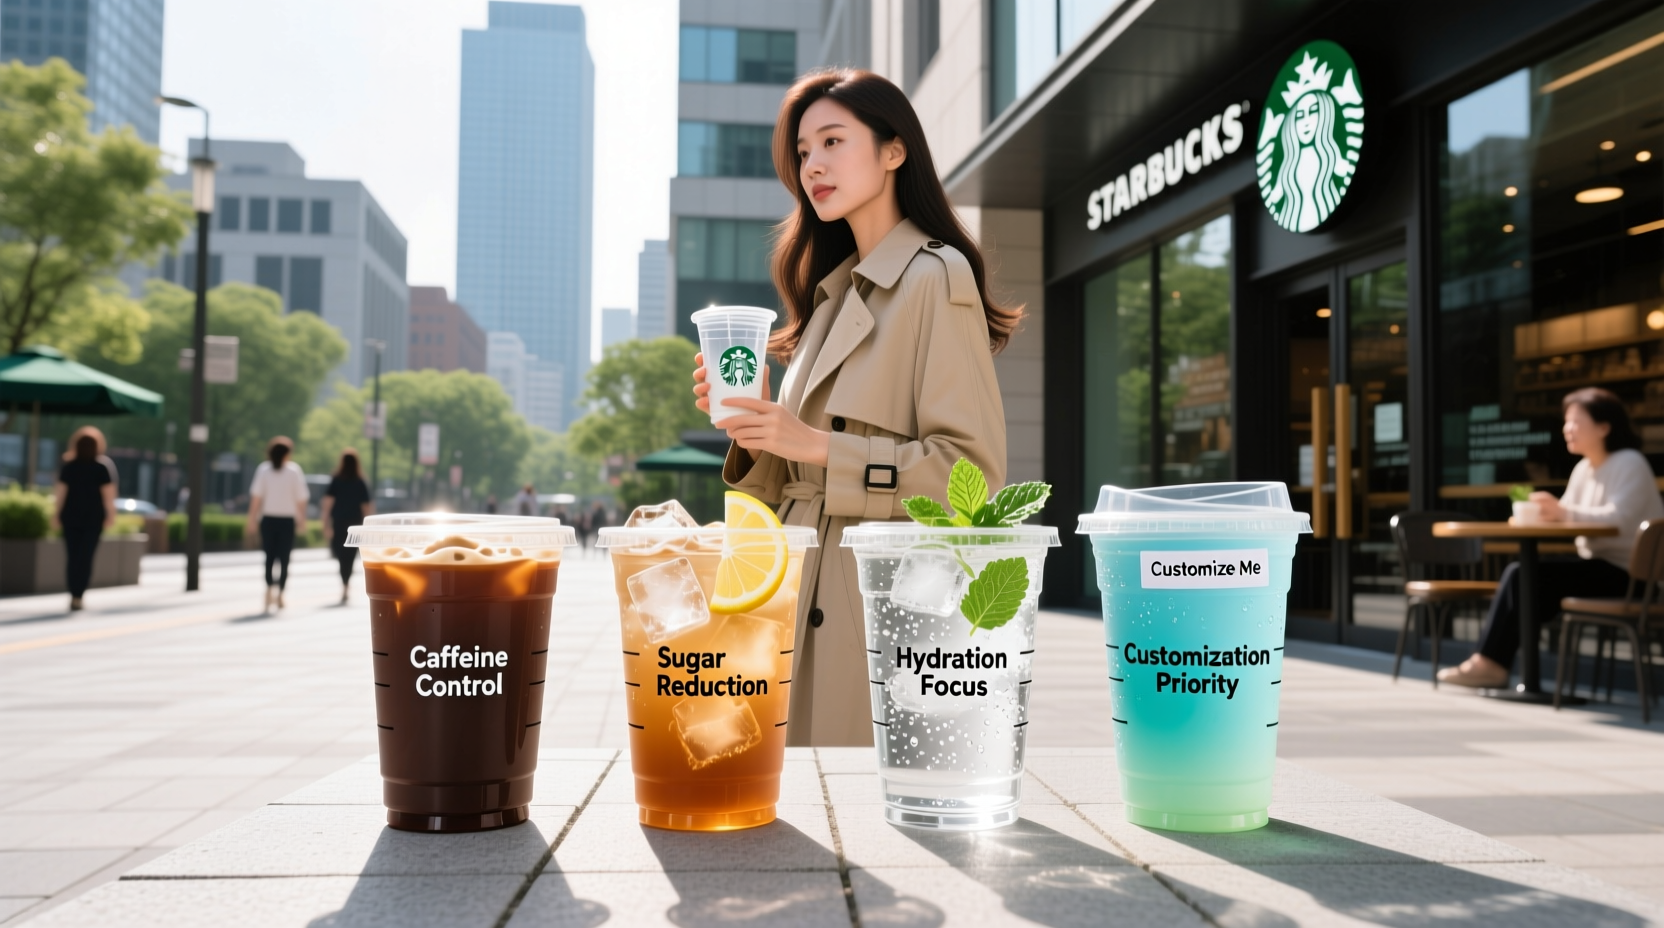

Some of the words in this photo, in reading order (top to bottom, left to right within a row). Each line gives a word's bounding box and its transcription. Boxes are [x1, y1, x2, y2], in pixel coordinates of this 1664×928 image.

[1087, 103, 1244, 231] STARBUCKS
[1150, 560, 1235, 577] Customize
[1239, 559, 1261, 576] Me
[410, 645, 508, 669] Caffeine
[657, 646, 726, 674] Sugar
[896, 646, 1008, 674] Hydration
[1123, 643, 1271, 667] Customization
[415, 672, 503, 697] Control
[656, 674, 768, 697] Reduction
[920, 674, 988, 697] Focus
[1156, 671, 1240, 700] Priority
